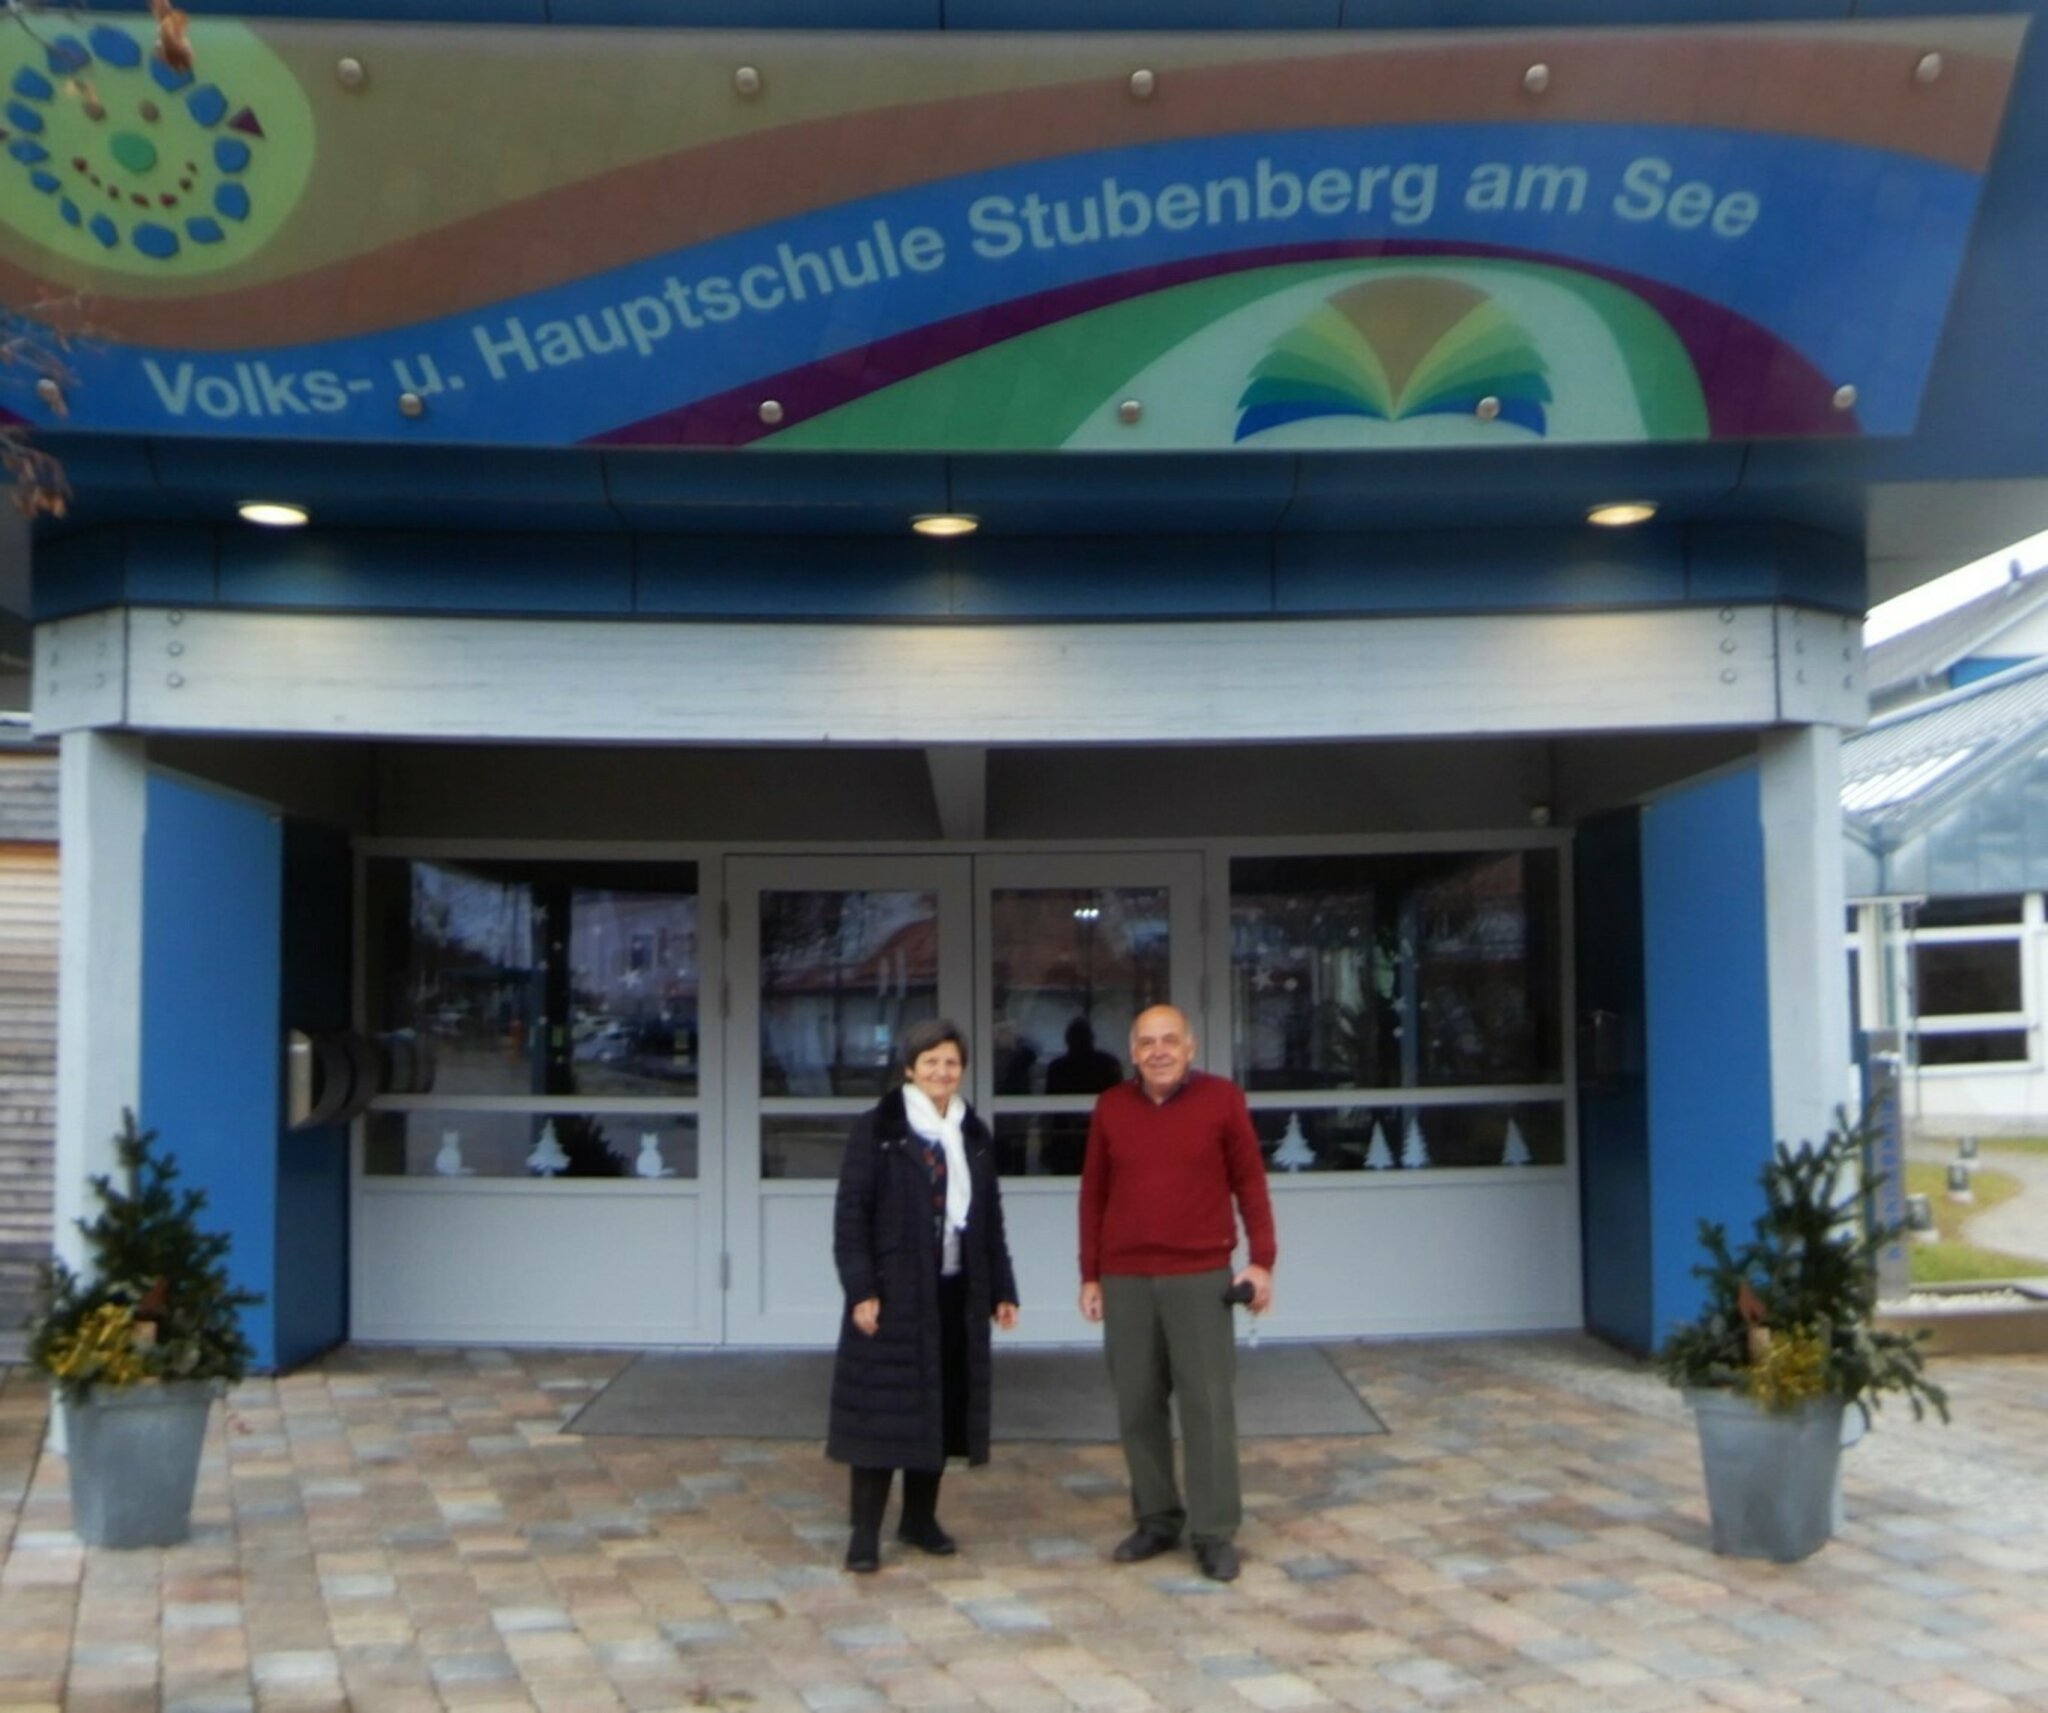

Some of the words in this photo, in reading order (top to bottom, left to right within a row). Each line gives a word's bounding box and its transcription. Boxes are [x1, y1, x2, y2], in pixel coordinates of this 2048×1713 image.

[142, 357, 373, 418] Volks-
[391, 353, 465, 397] u.
[472, 219, 945, 380] Hauptschule
[967, 158, 1439, 259] Stubenberg
[1464, 161, 1589, 214] am
[1612, 155, 1760, 238] See
